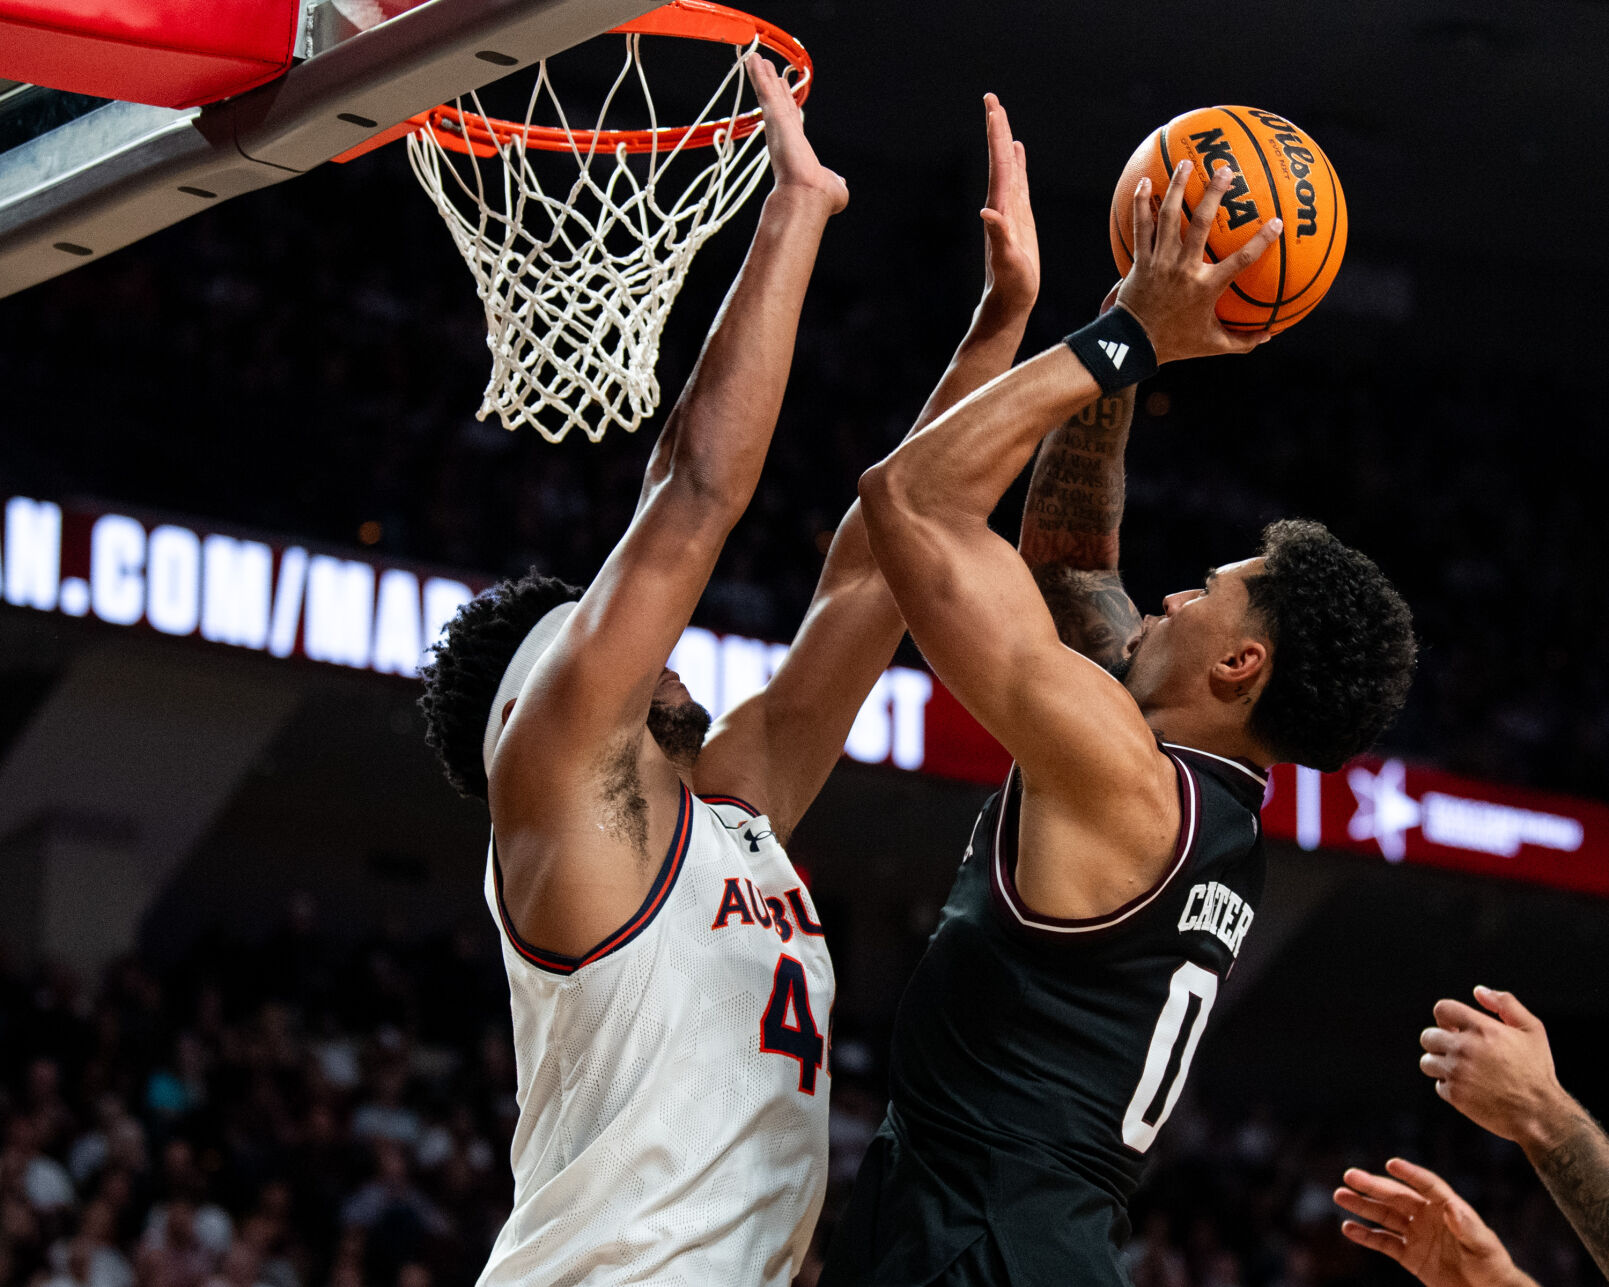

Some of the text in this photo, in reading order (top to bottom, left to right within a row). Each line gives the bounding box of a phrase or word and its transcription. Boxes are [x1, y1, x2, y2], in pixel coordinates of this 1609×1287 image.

[1189, 127, 1260, 231] NCAA
[1248, 109, 1317, 239] Wilson
[759, 952, 832, 1097] 4
[1122, 960, 1219, 1155] 0
